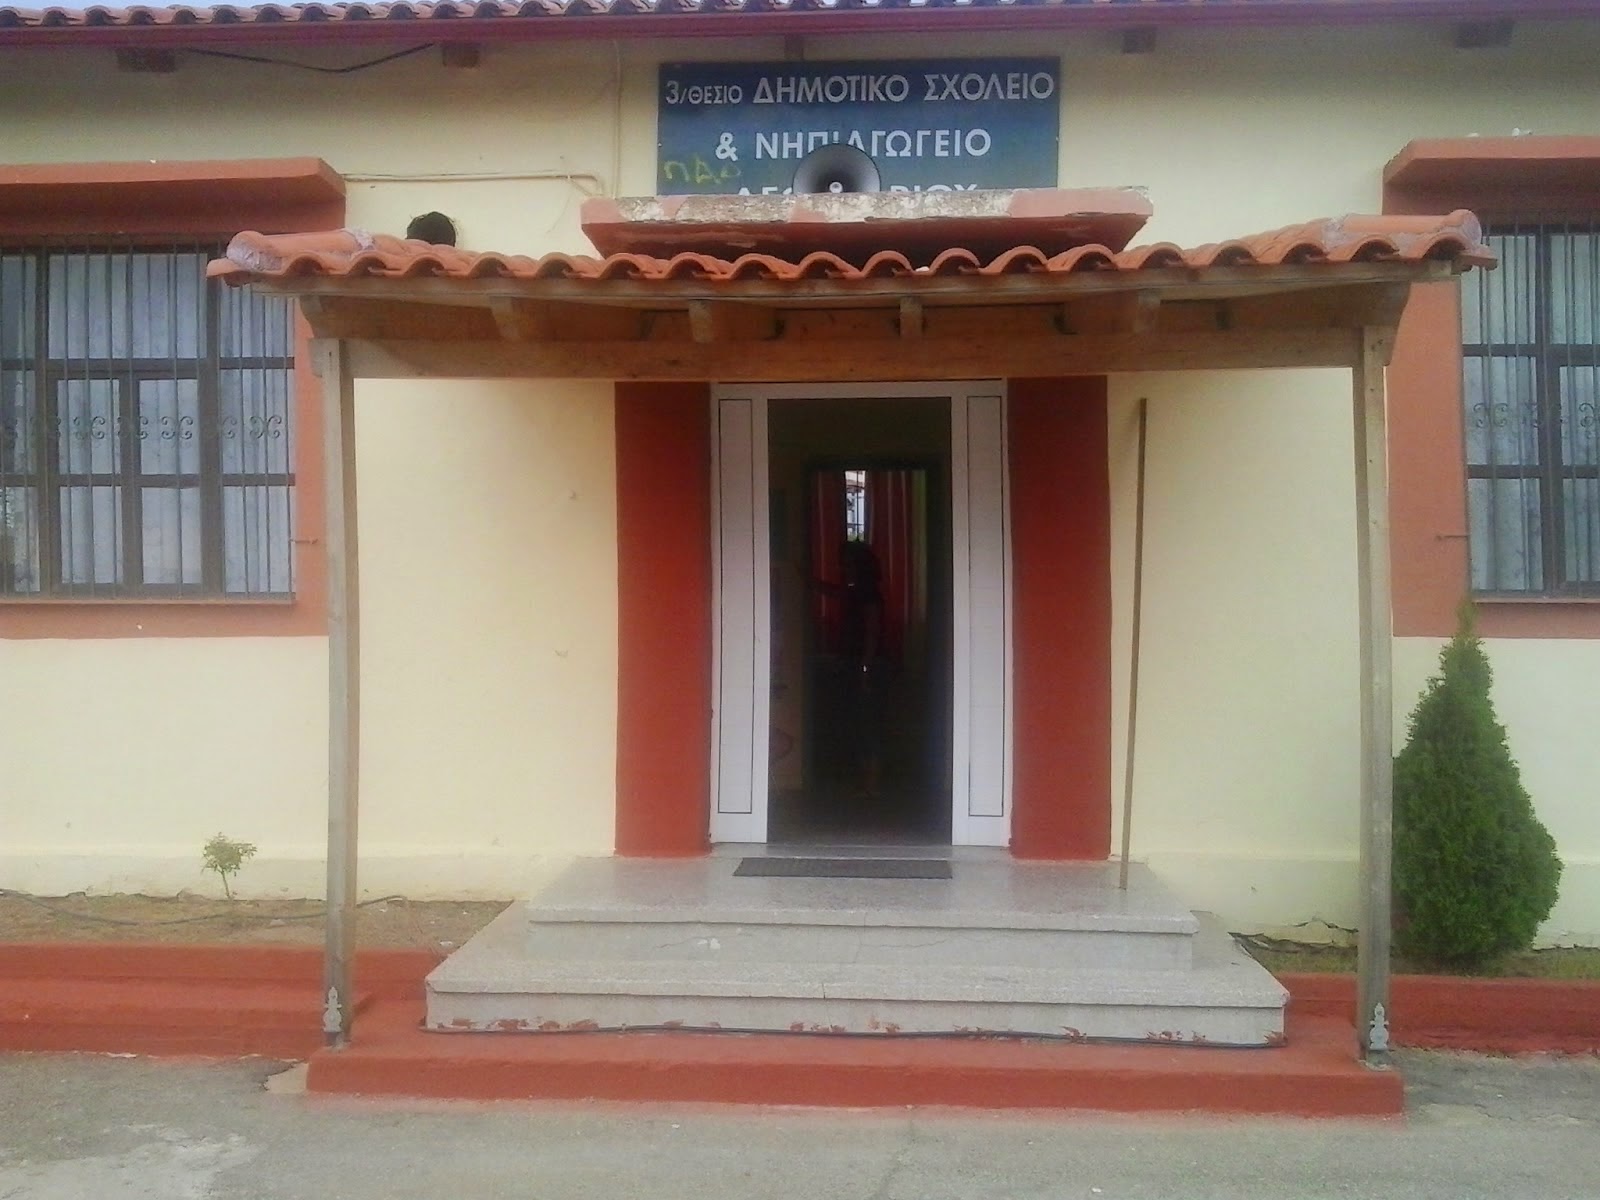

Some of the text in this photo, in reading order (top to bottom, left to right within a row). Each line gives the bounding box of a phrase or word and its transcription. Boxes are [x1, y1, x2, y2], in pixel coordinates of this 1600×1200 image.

[665, 72, 1055, 105] 3/ΘΕΣΙΟ ΔΗΜΟΤΙΚΟ ΣΧΟΛΕΙΟ
[714, 132, 738, 161] &
